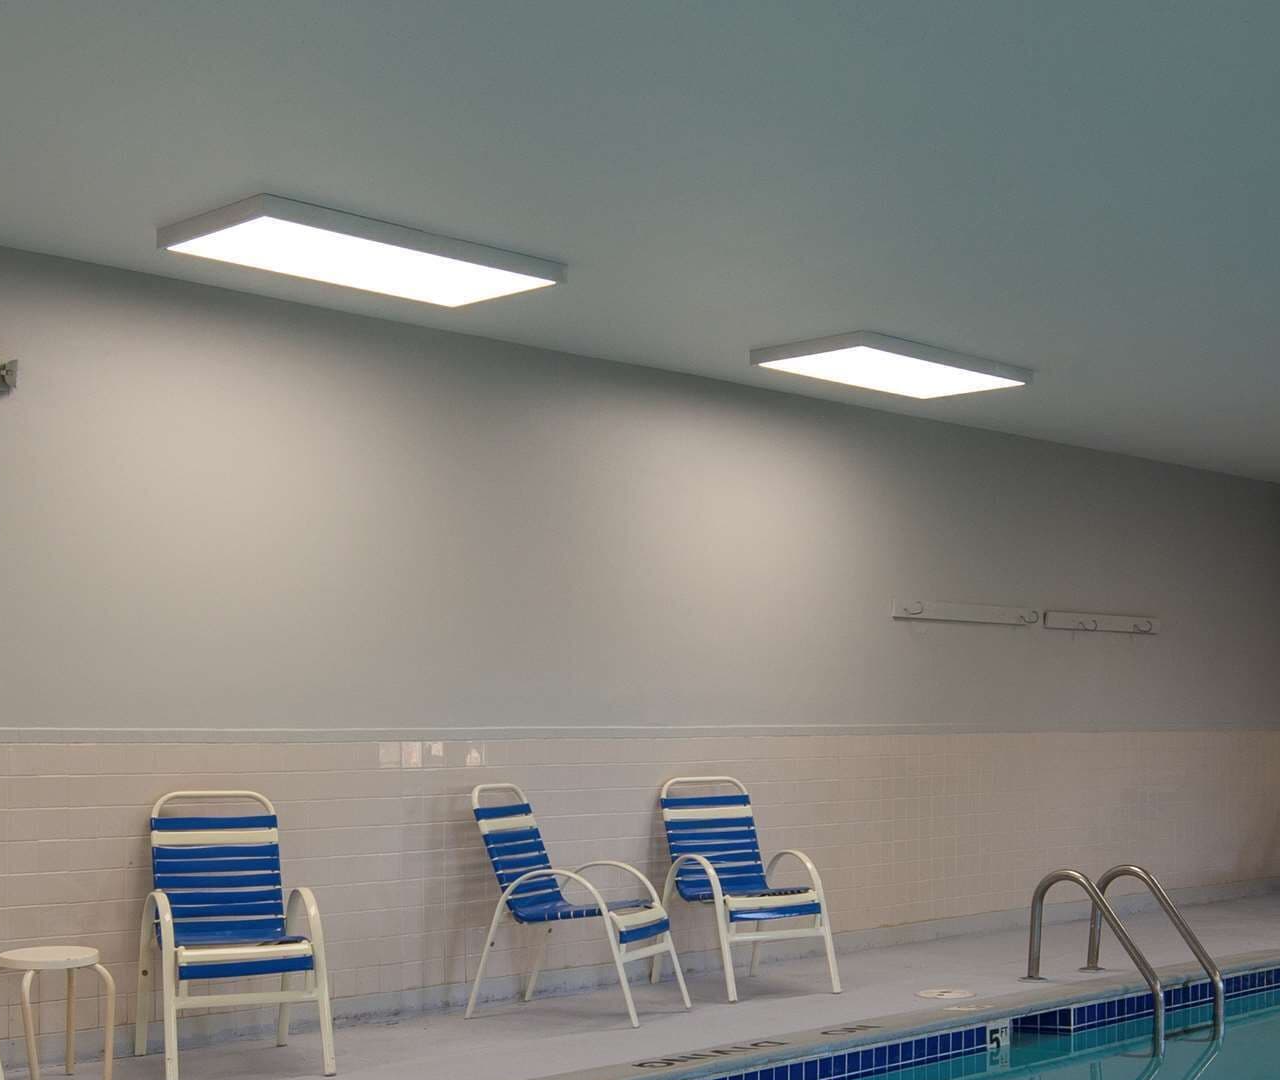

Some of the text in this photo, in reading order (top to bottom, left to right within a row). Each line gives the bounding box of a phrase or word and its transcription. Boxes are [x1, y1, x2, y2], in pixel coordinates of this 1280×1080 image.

[633, 1022, 885, 1070] NO DIVING
[989, 1028, 1001, 1050] 5
